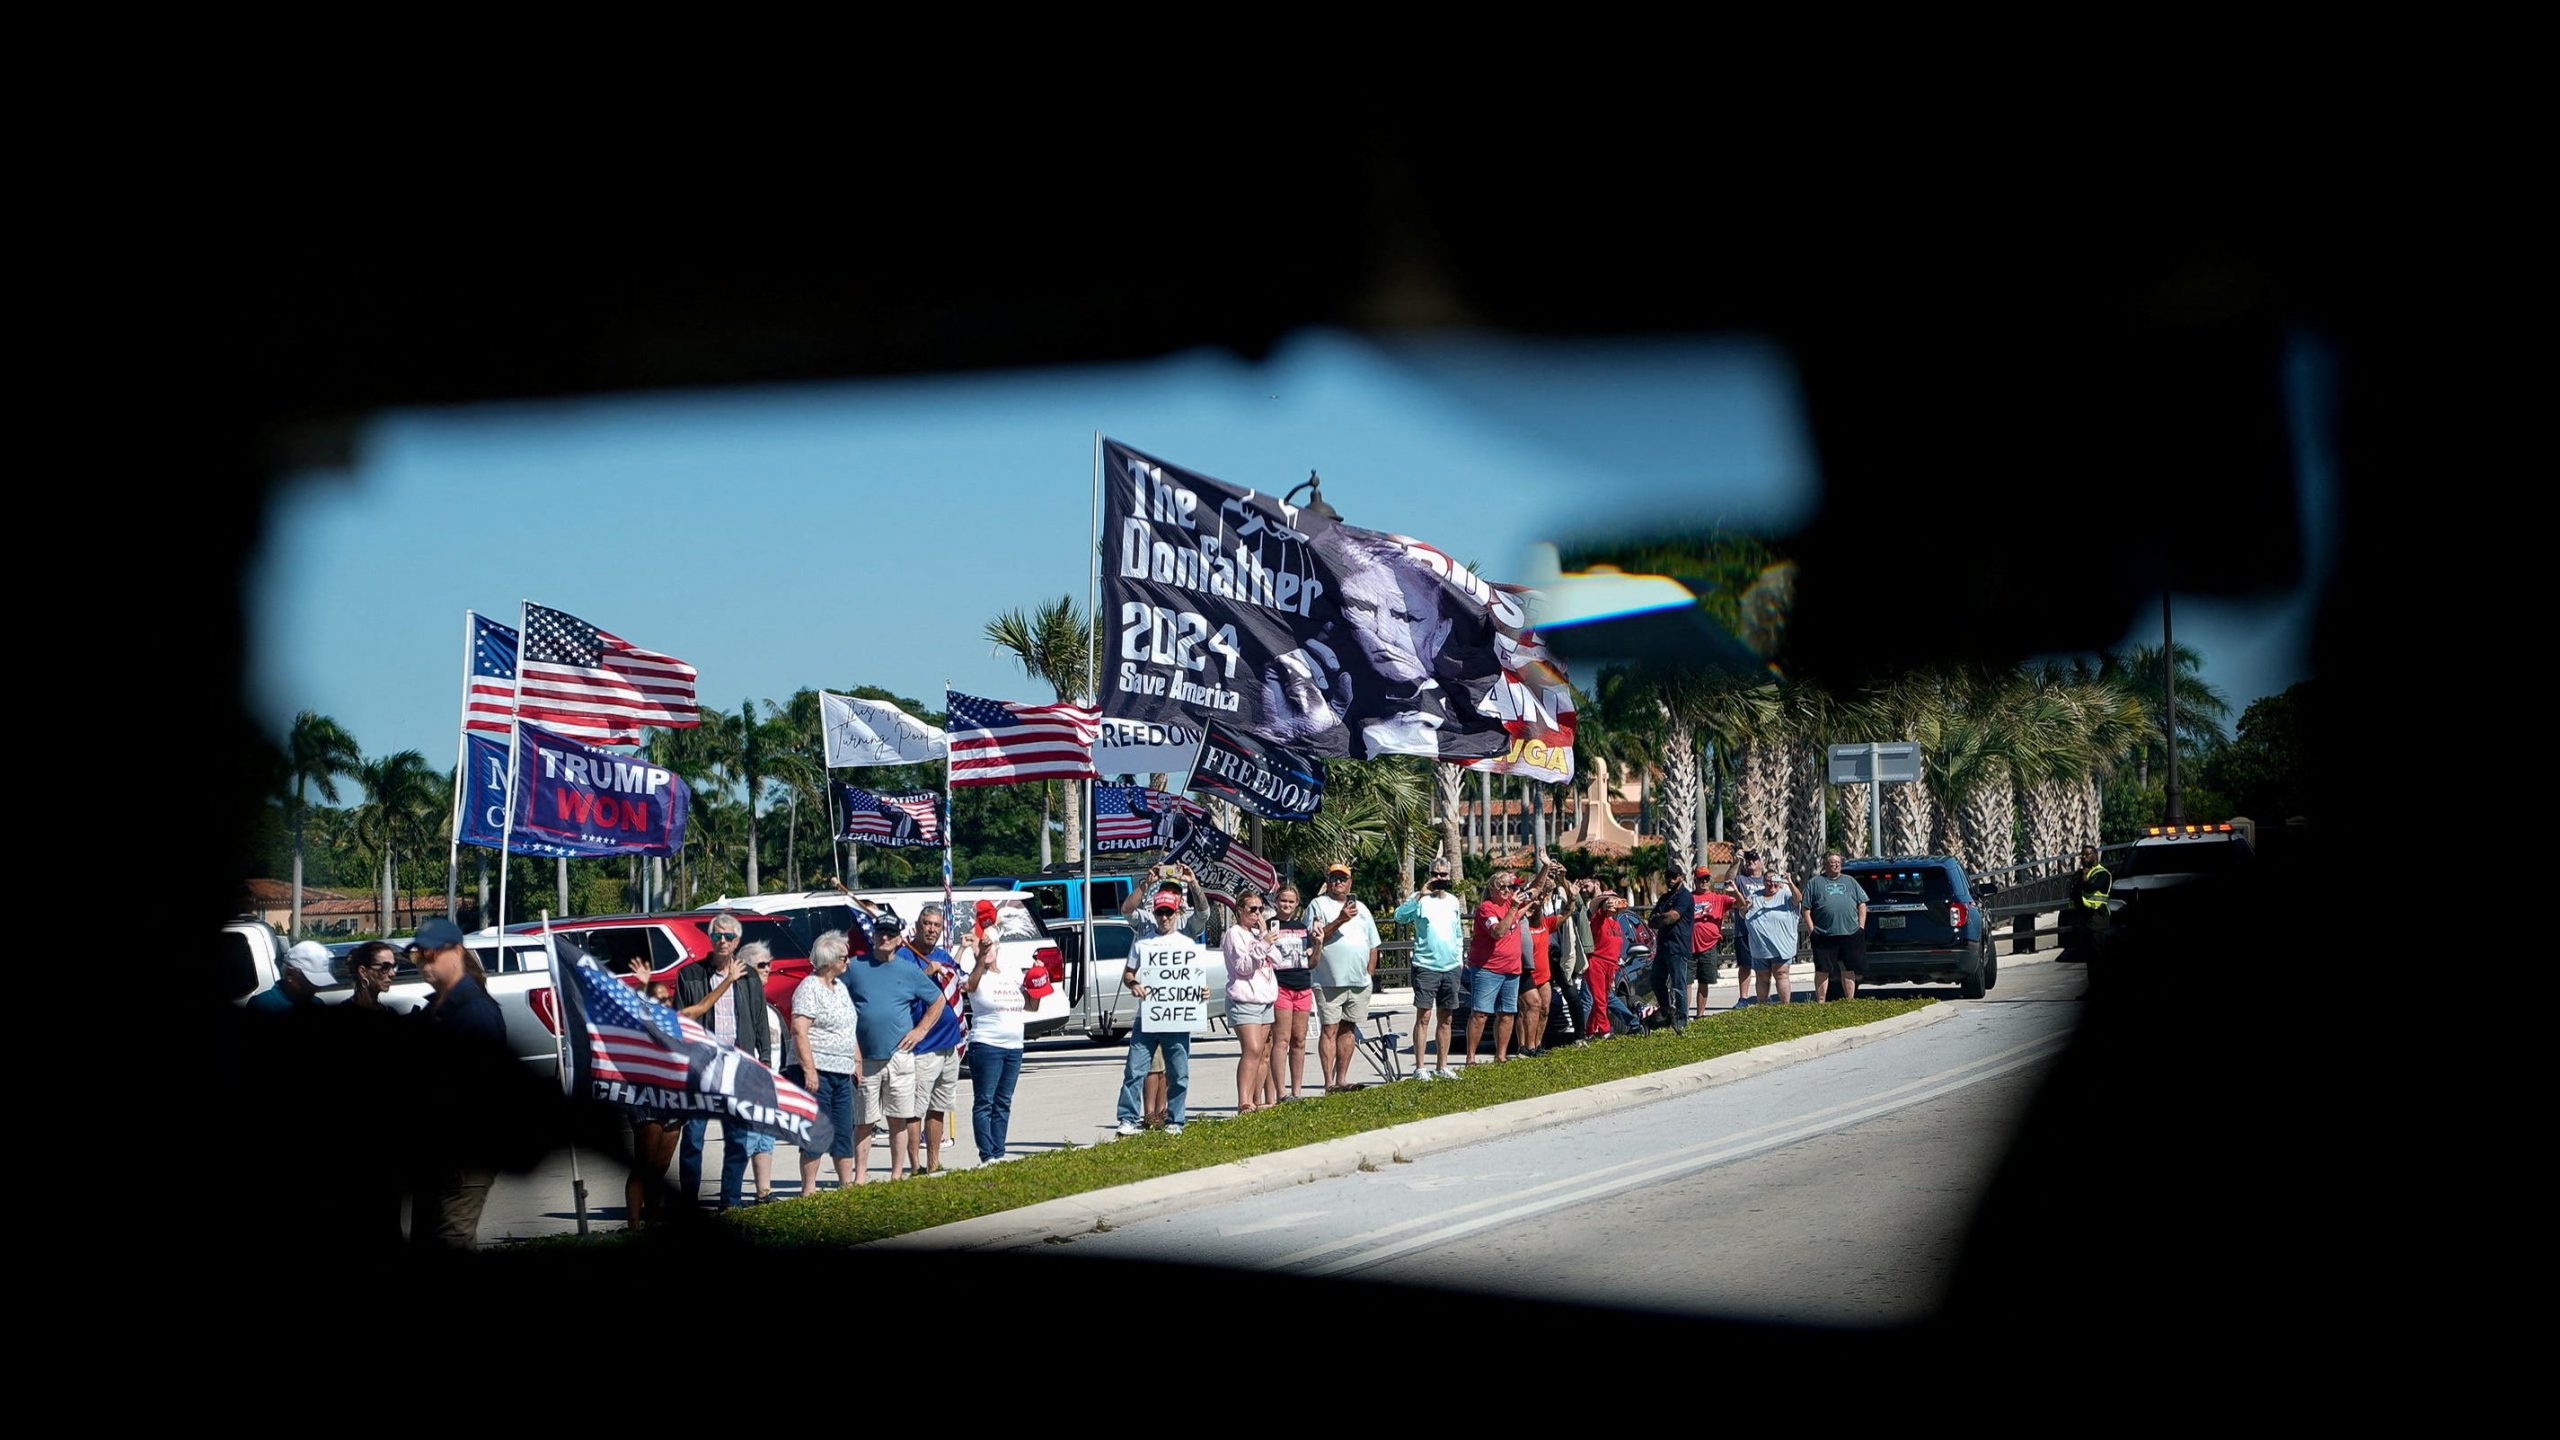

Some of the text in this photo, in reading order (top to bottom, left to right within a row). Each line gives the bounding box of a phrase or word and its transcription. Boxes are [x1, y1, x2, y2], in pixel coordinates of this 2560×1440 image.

[1127, 458, 1198, 530] The
[1120, 516, 1323, 618] Donfather
[1121, 601, 1240, 679] 2024
[1119, 662, 1239, 712] Save America
[831, 718, 890, 761] Turning
[539, 747, 671, 795] TRUMP
[1202, 745, 1320, 812] FREEDOM
[556, 786, 649, 833] WON
[881, 792, 937, 805] PATRIOT
[847, 832, 904, 847] CHARLIE
[1148, 951, 1196, 967] KEEP
[1159, 968, 1190, 981] OUR
[1149, 1006, 1197, 1022] SAFE
[592, 1080, 813, 1142] CHARLIE KIRK
